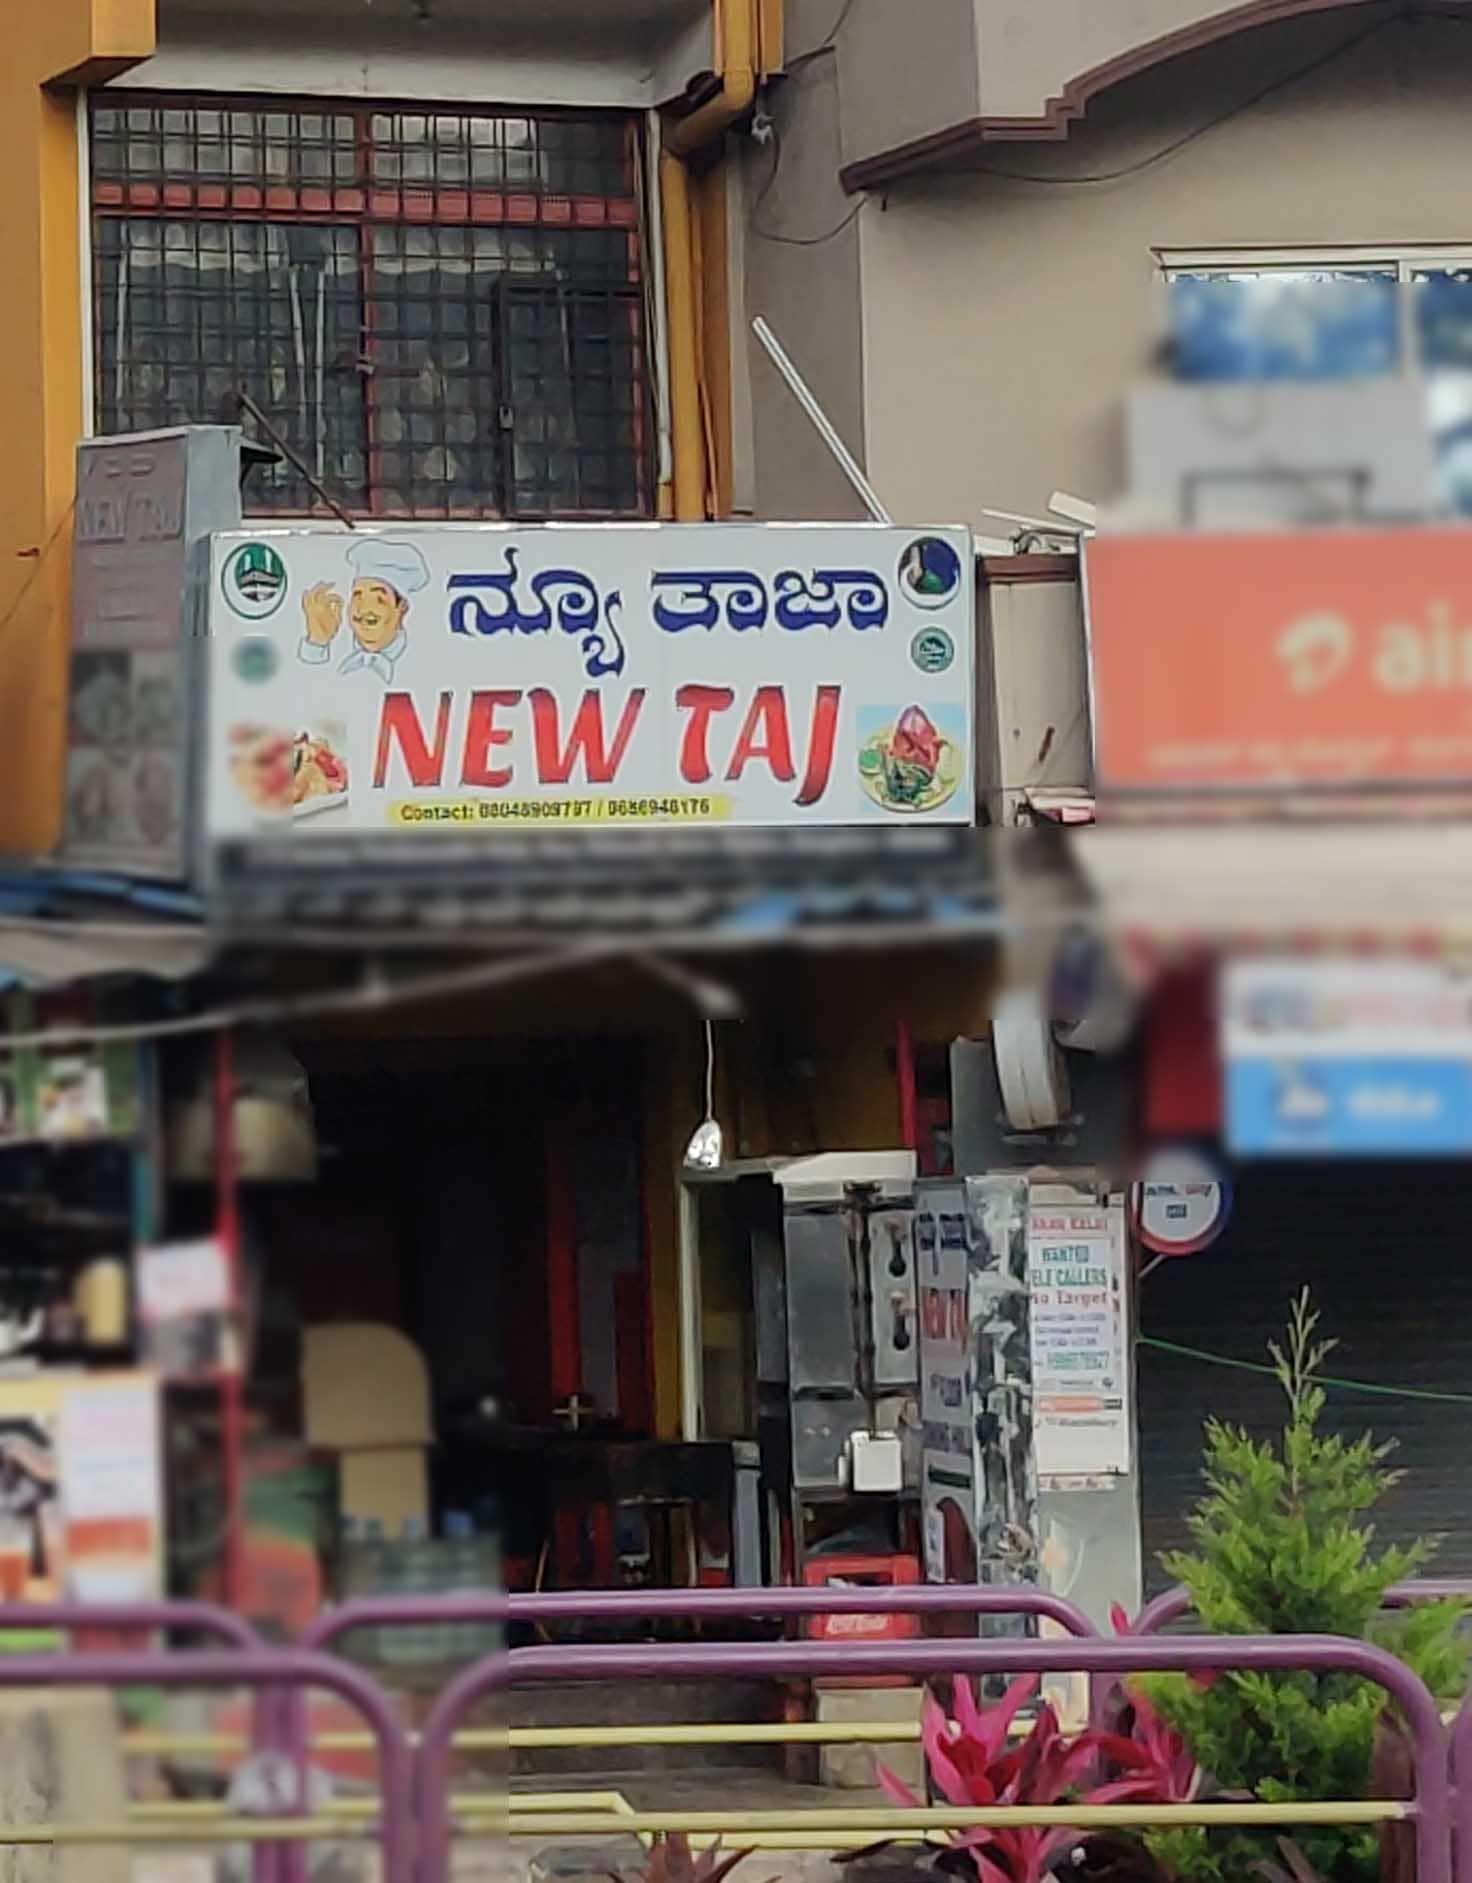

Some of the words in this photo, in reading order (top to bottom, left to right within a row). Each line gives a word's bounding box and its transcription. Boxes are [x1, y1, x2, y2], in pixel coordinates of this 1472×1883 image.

[650, 569, 890, 633] ತಾಜಾ
[372, 687, 646, 789] NEW
[676, 684, 841, 805] TAJ
[401, 803, 473, 821] Contact:
